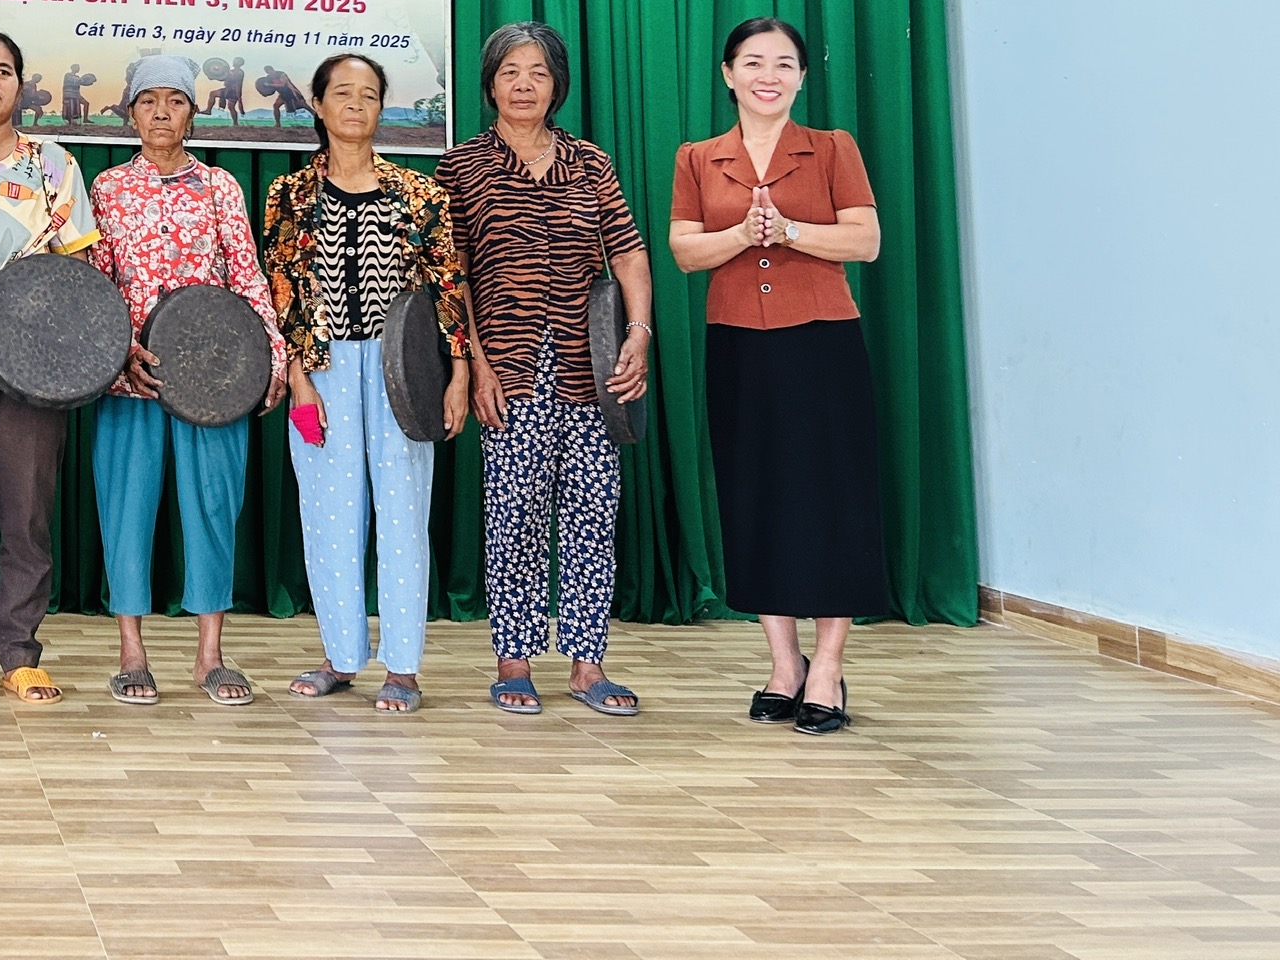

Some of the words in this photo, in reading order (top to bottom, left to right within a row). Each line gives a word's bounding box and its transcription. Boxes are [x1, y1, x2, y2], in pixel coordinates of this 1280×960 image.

[75, 22, 106, 37] Cát
[111, 24, 146, 38] Tiên
[152, 26, 166, 41] 3,
[173, 27, 216, 43] ngày
[221, 29, 241, 41] 20
[247, 30, 296, 47] tháng
[304, 32, 320, 44] 11
[327, 33, 363, 46] năm
[370, 34, 410, 48] 2025
